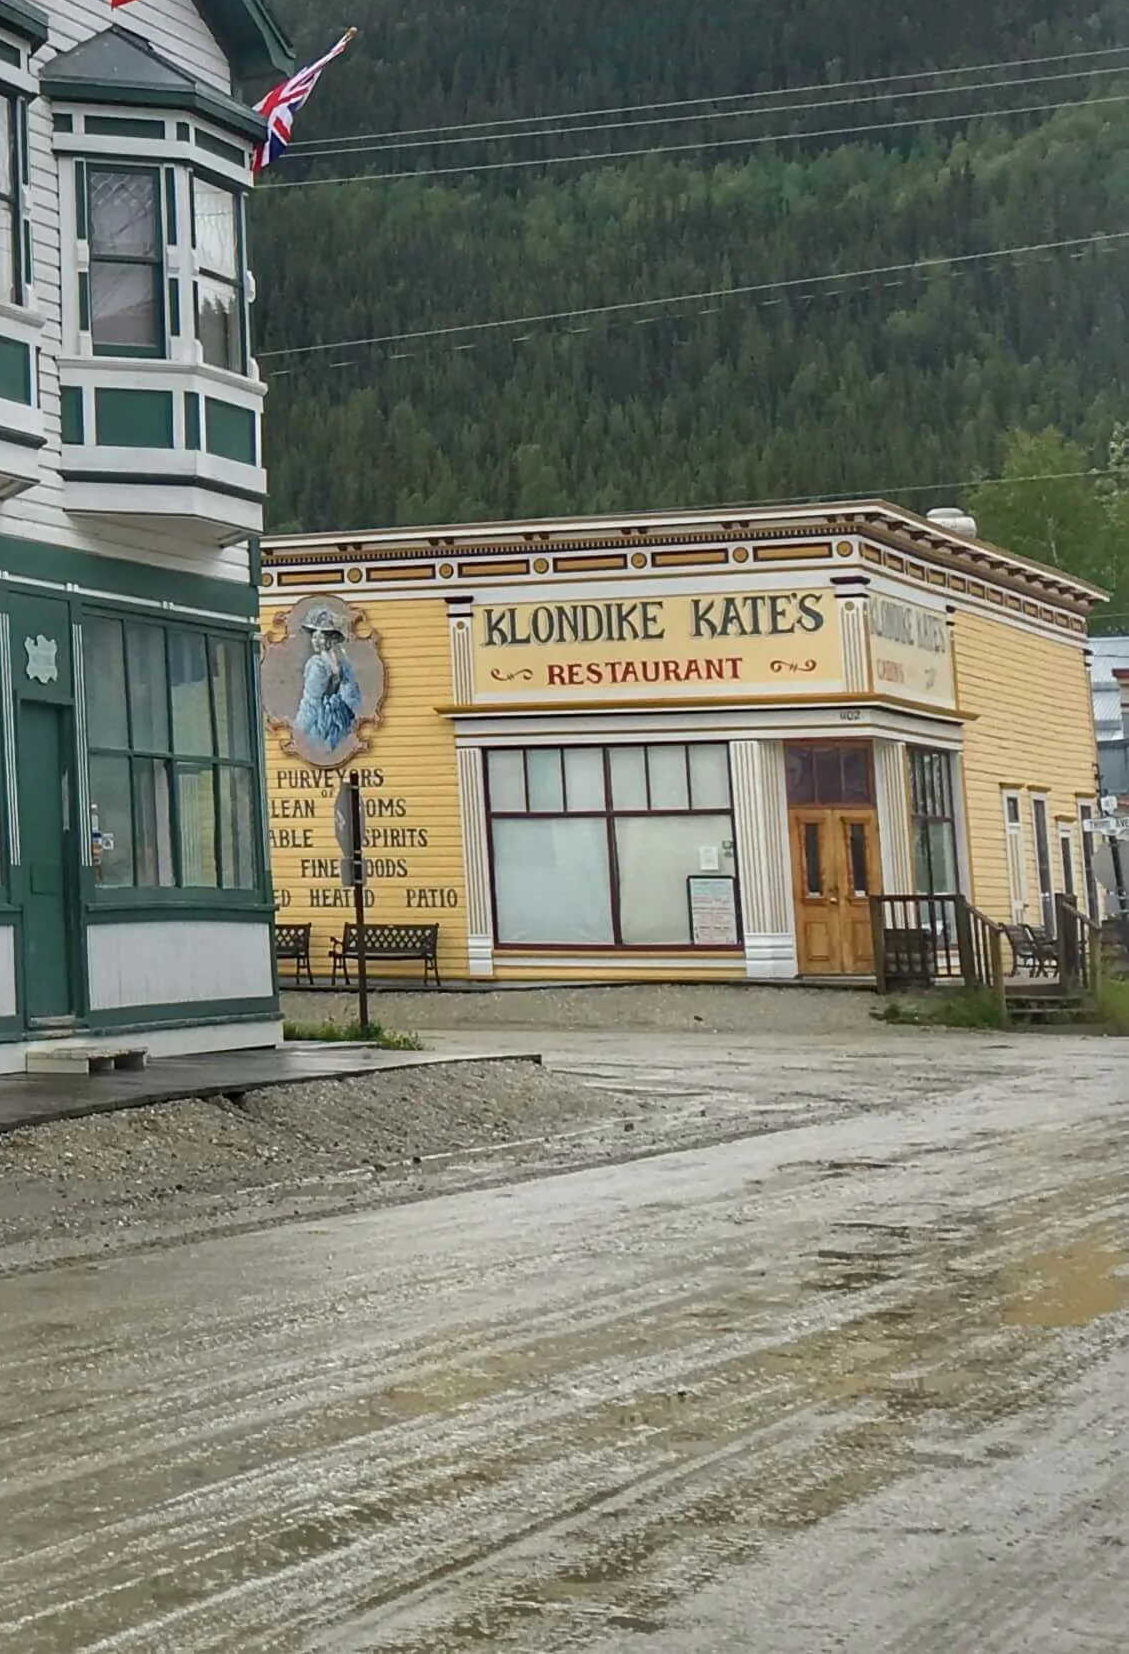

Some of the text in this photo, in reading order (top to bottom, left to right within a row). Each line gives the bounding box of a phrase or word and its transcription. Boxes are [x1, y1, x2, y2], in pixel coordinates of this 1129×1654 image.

[481, 593, 826, 648] KLONDIKE KATE'S
[547, 658, 744, 686] RESTAURANT
[321, 789, 333, 798] OF
[271, 798, 406, 818] LEAN OMS
[269, 828, 428, 848] ABLE SPIRITS
[301, 858, 408, 878] FINE OODS
[310, 888, 375, 908] HEATD
[406, 888, 458, 908] PATIO
